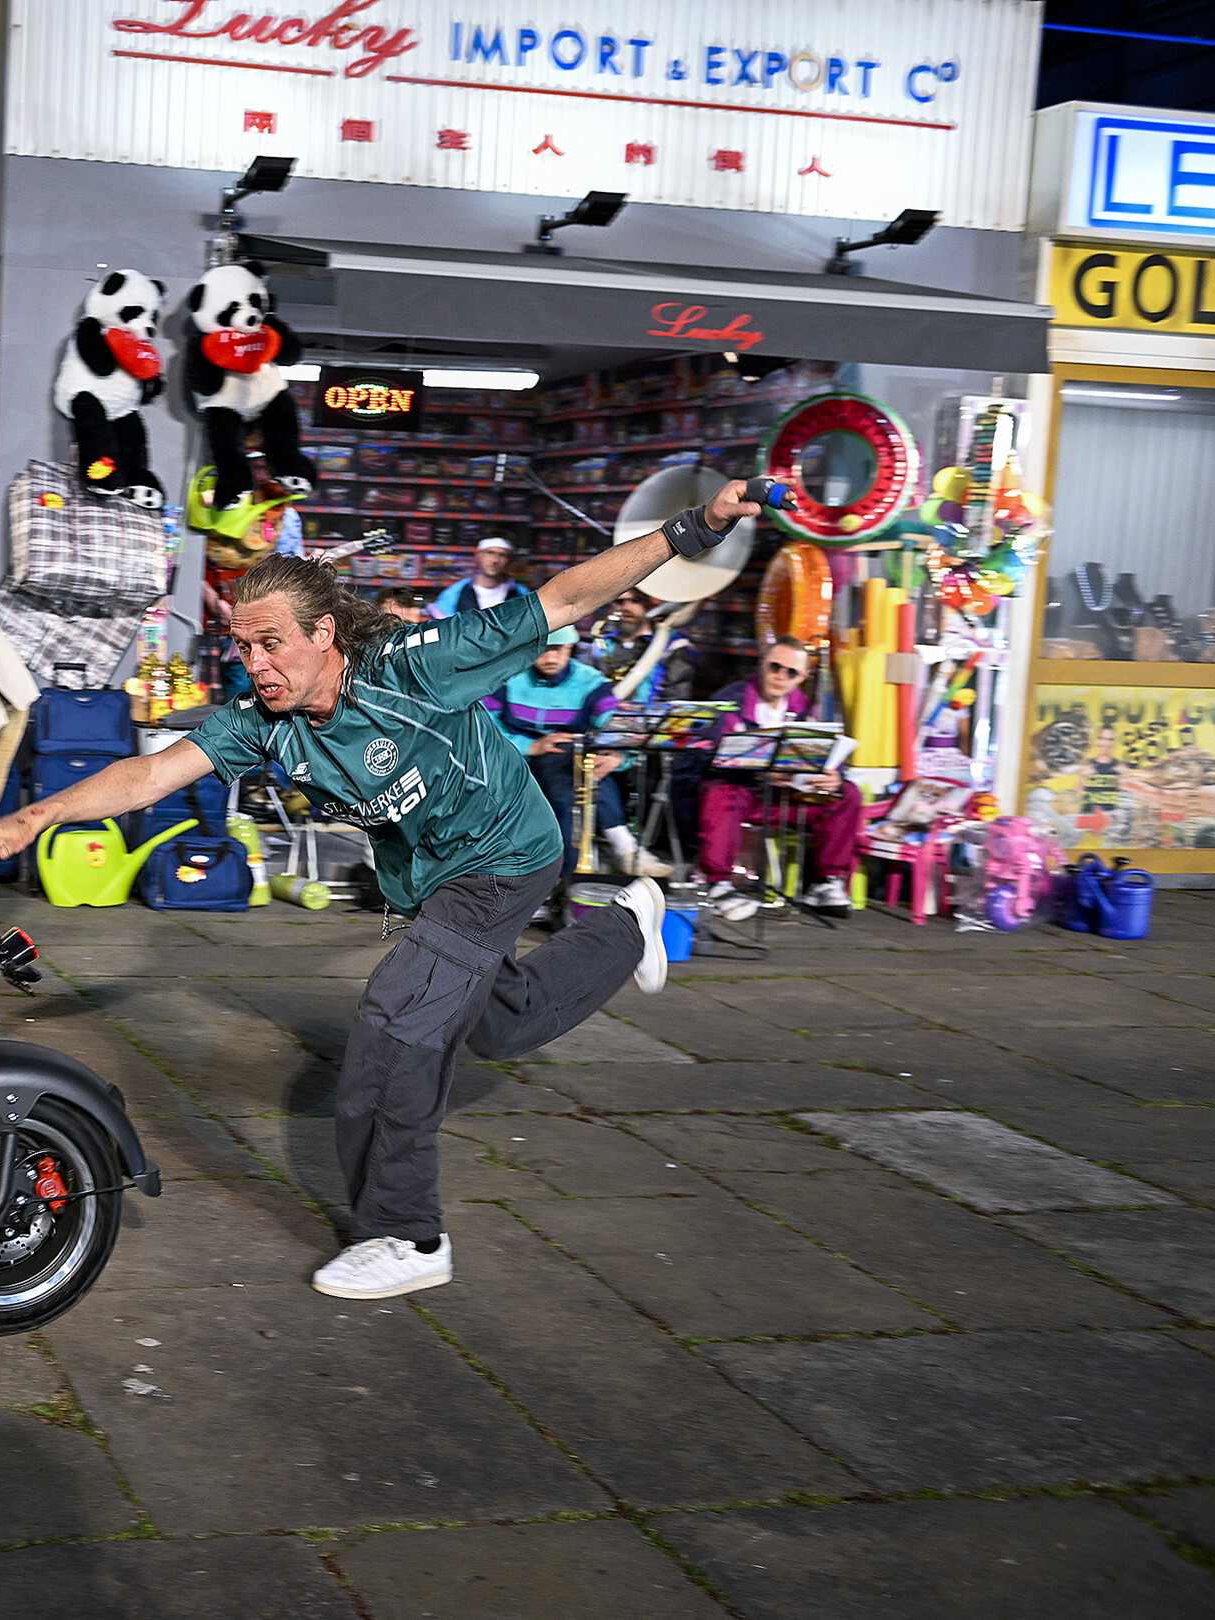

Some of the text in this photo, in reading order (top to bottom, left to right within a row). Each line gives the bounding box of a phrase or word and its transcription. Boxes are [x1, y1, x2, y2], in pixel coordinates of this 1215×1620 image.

[449, 20, 654, 78] IMPORT
[666, 58, 689, 81] &
[705, 44, 882, 98] EXPORT
[324, 386, 415, 412] OPEN
